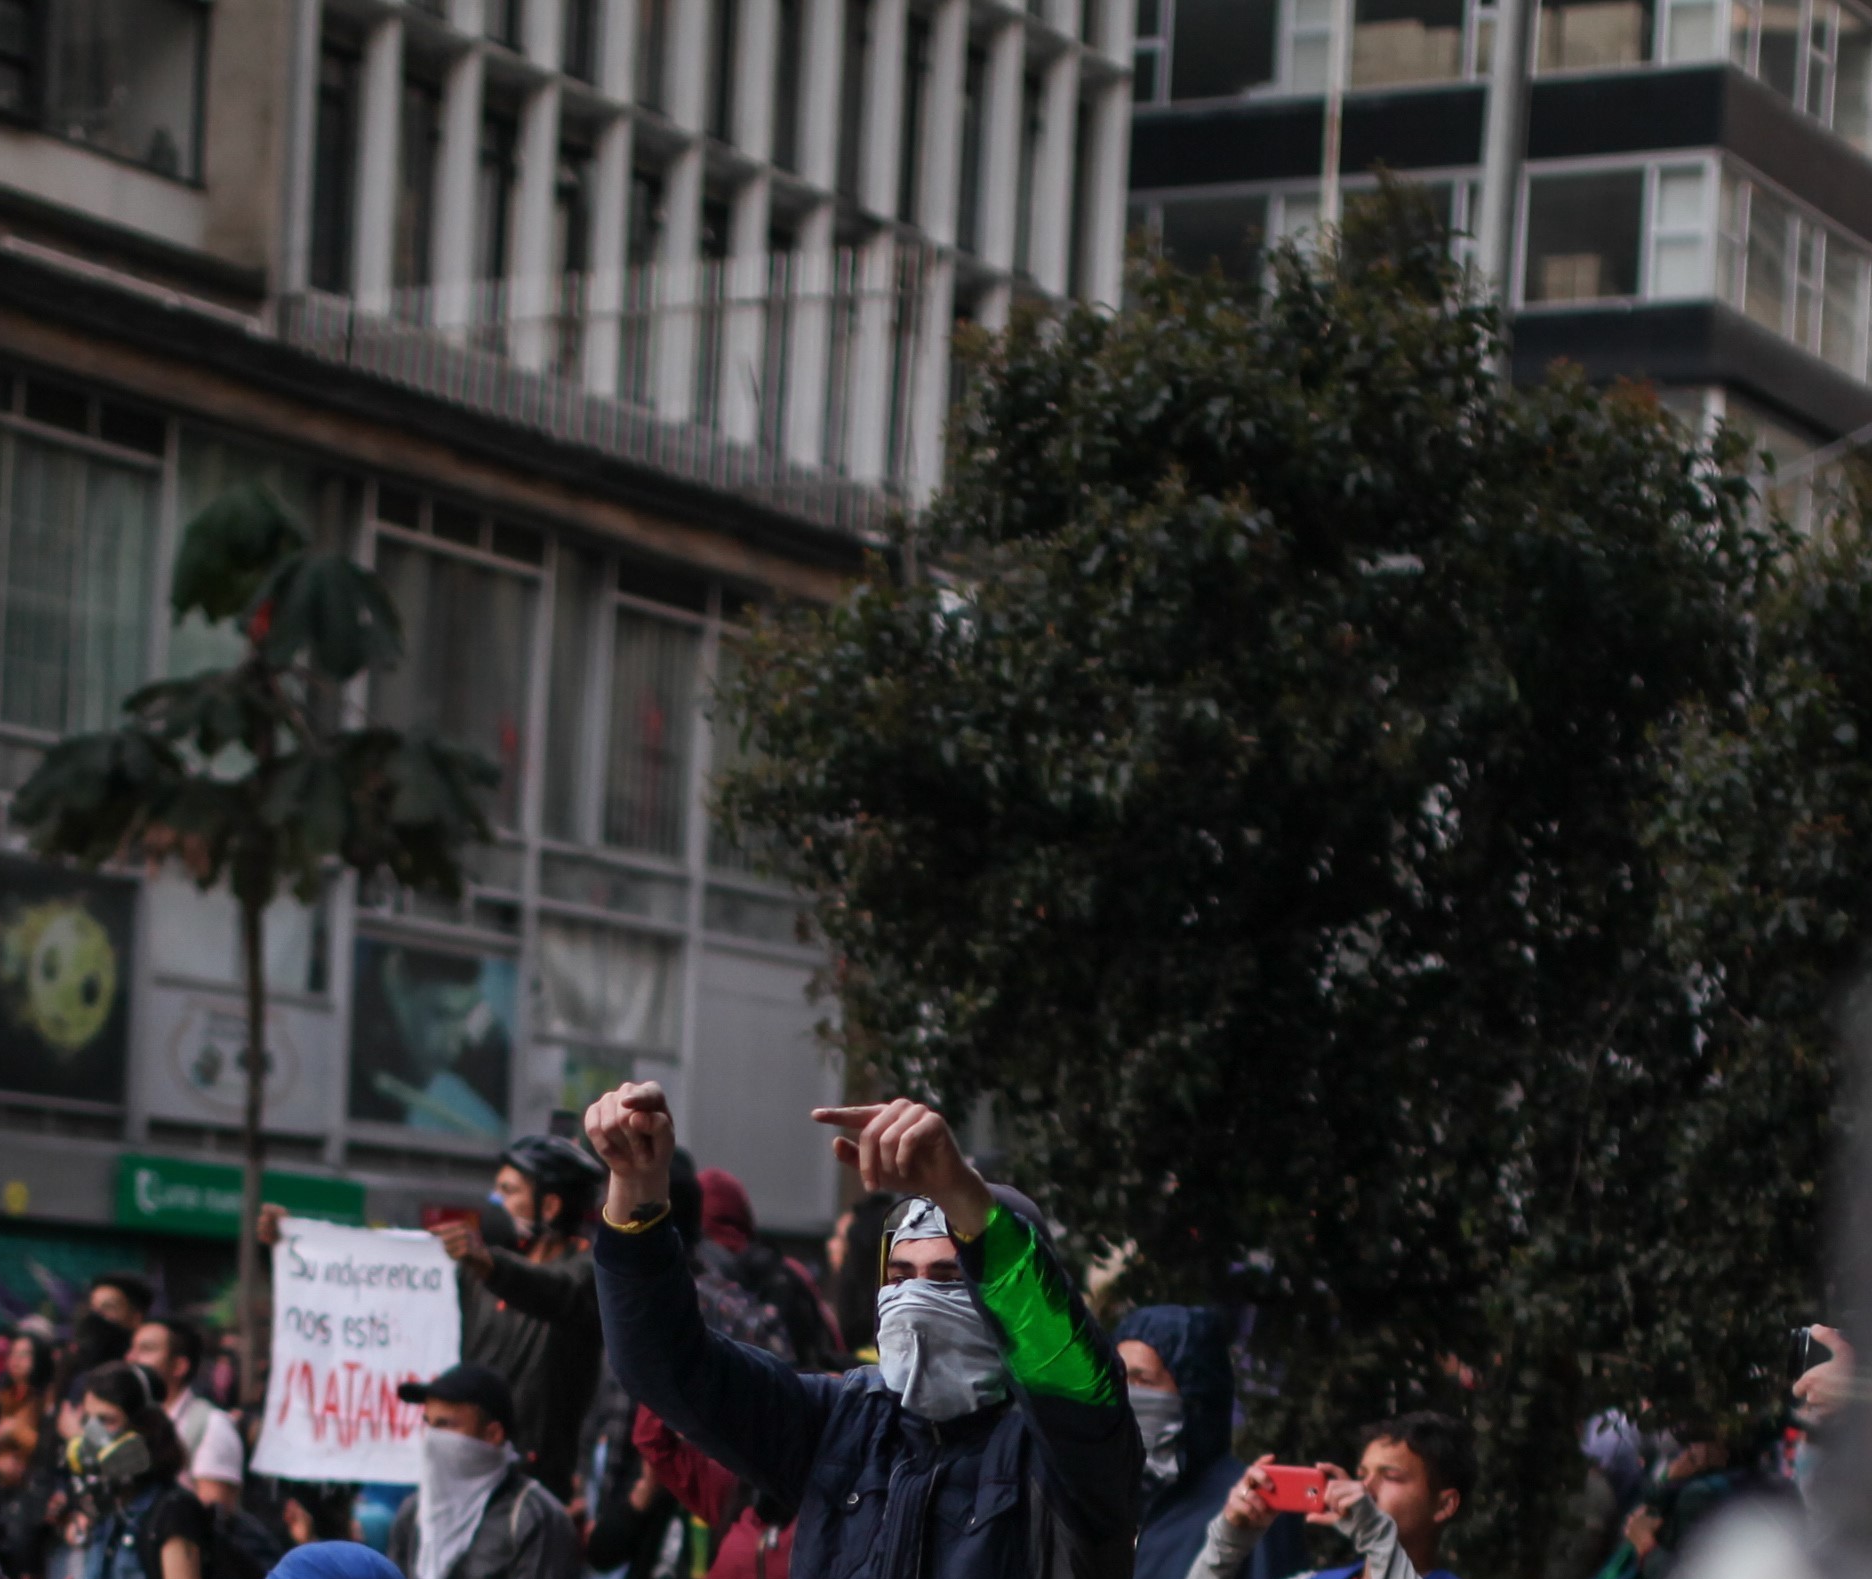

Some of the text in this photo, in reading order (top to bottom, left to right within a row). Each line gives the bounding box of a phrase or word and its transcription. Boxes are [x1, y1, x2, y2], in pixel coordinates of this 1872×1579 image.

[288, 1234, 318, 1281] Su
[285, 1305, 333, 1345] nos
[278, 1358, 437, 1449] MATAND
